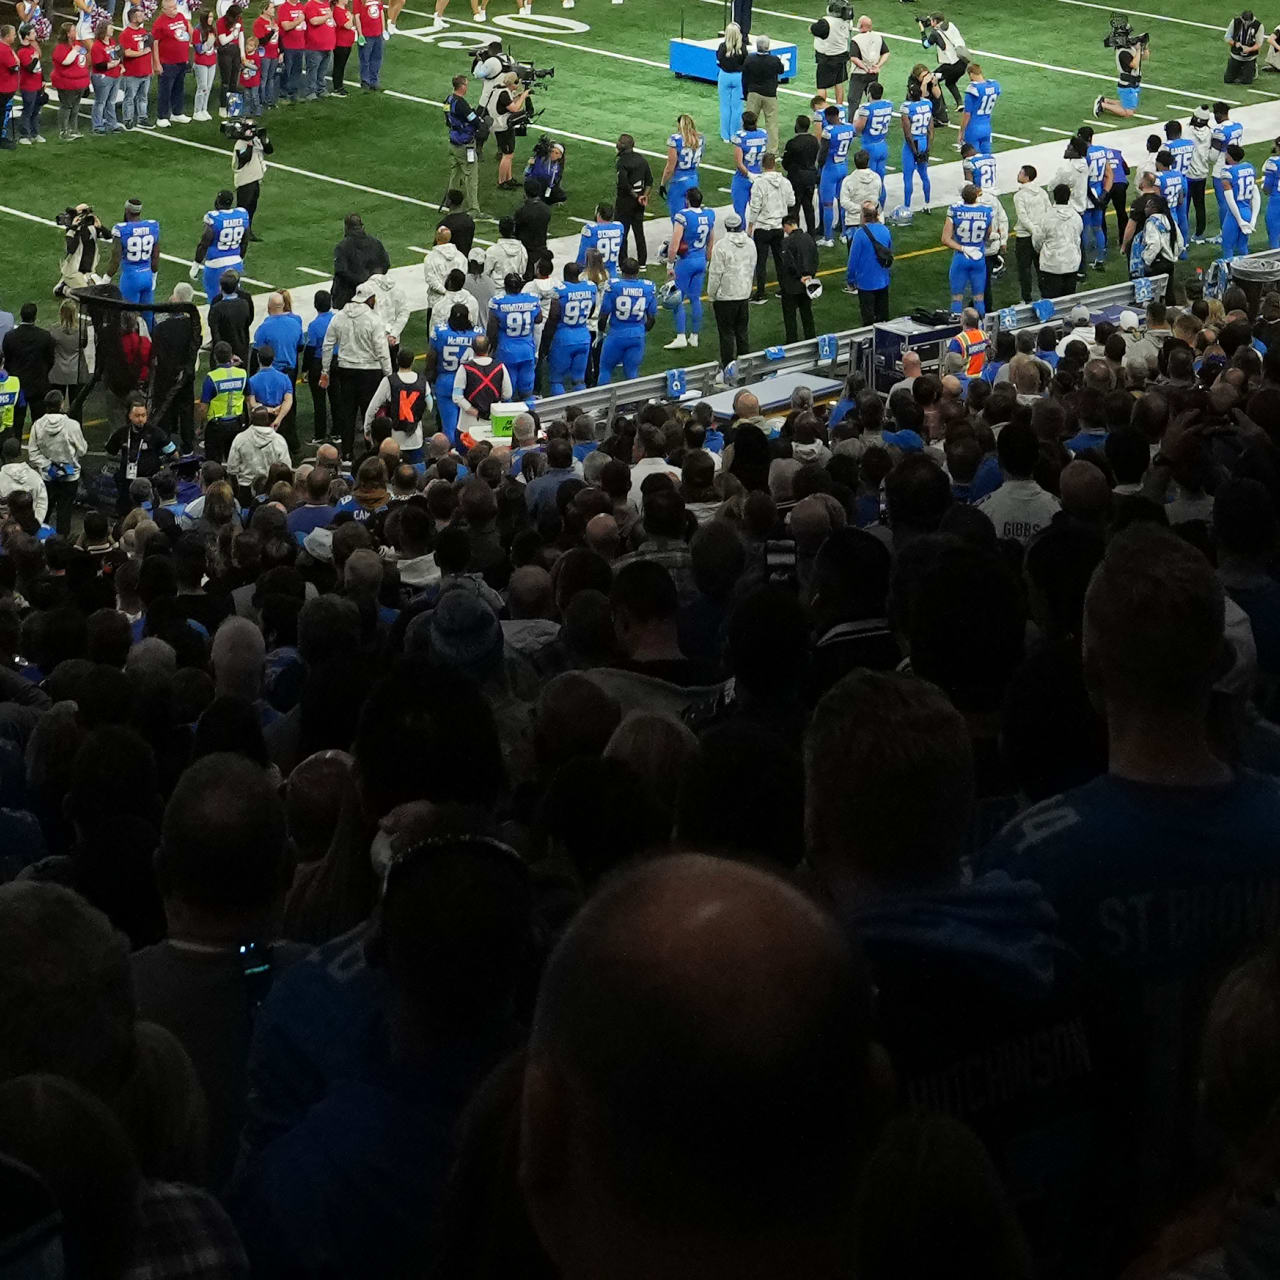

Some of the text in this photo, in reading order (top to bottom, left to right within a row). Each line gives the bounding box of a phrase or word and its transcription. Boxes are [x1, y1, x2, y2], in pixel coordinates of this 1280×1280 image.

[978, 94, 998, 116] 16
[956, 210, 988, 221] CAMPBELL
[217, 227, 246, 251] 98
[695, 224, 710, 250] 3
[955, 220, 986, 244] 46
[127, 235, 155, 262] 99
[623, 287, 644, 298] WINGO
[564, 299, 593, 326] 93
[615, 296, 647, 322] 94
[506, 310, 533, 338] 91
[1003, 521, 1040, 540] GIBBS
